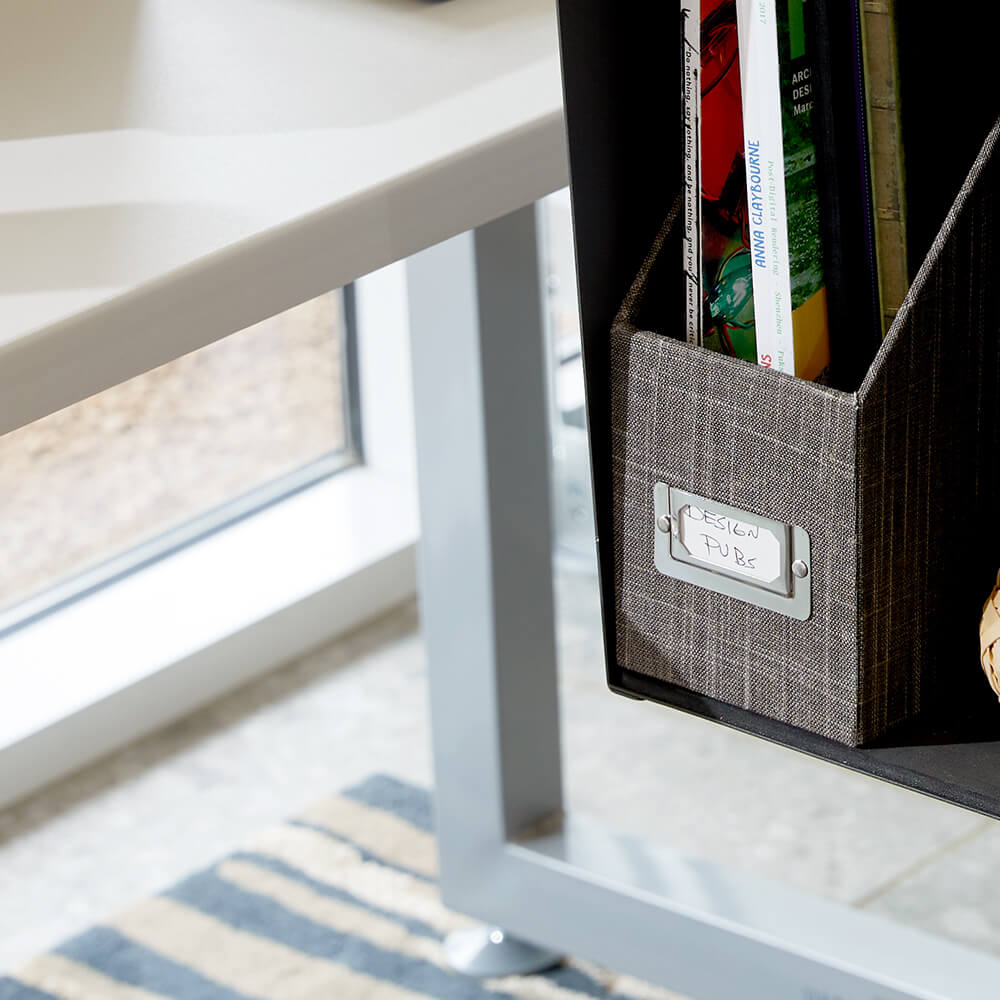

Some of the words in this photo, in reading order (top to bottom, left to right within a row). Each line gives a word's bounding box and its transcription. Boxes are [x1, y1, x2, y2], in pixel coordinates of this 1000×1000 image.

[748, 140, 764, 225] CLAYBOURNE
[752, 230, 767, 269] ANNA
[687, 504, 760, 539] DESIGN
[700, 533, 757, 569] PUBS
